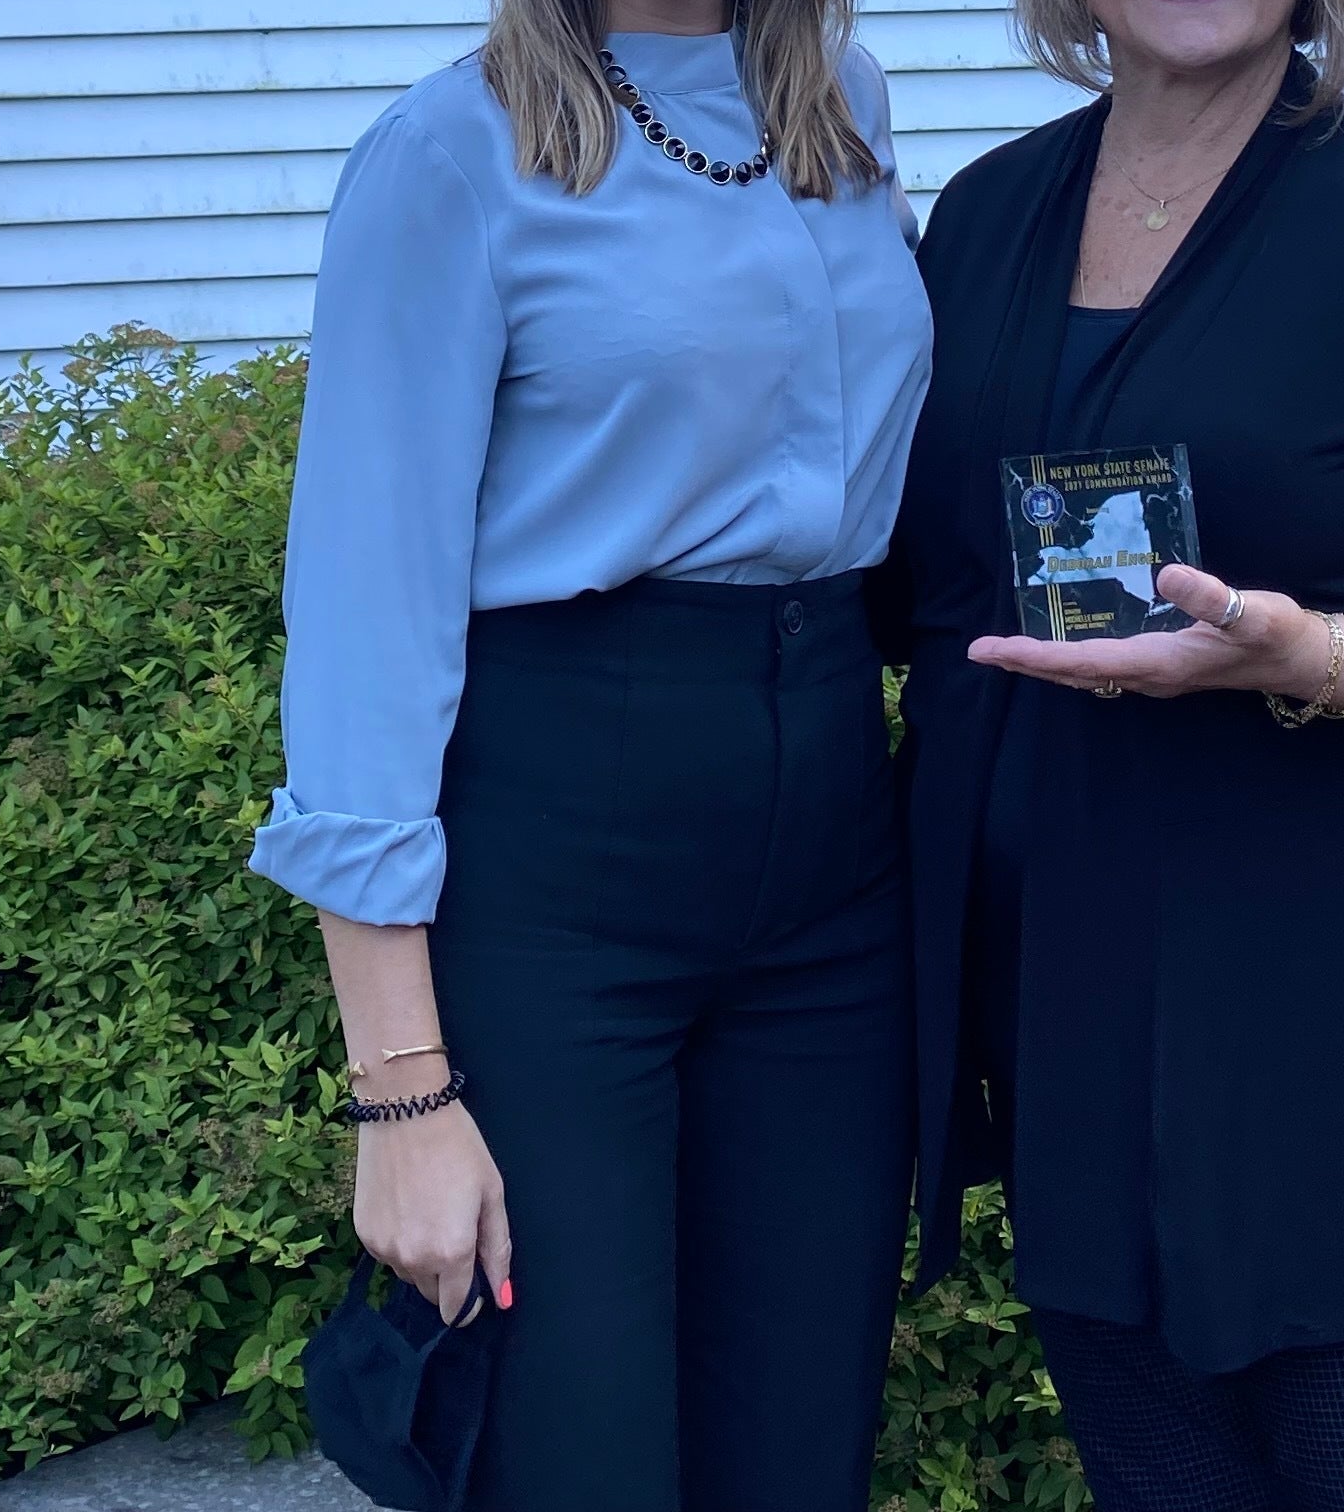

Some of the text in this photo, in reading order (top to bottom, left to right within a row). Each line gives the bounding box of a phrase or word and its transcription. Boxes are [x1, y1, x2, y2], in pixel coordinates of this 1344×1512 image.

[1049, 457, 1171, 480] NEW YORK STATE SENATE
[1064, 472, 1173, 492] 2021 COMMENDATION AWARD
